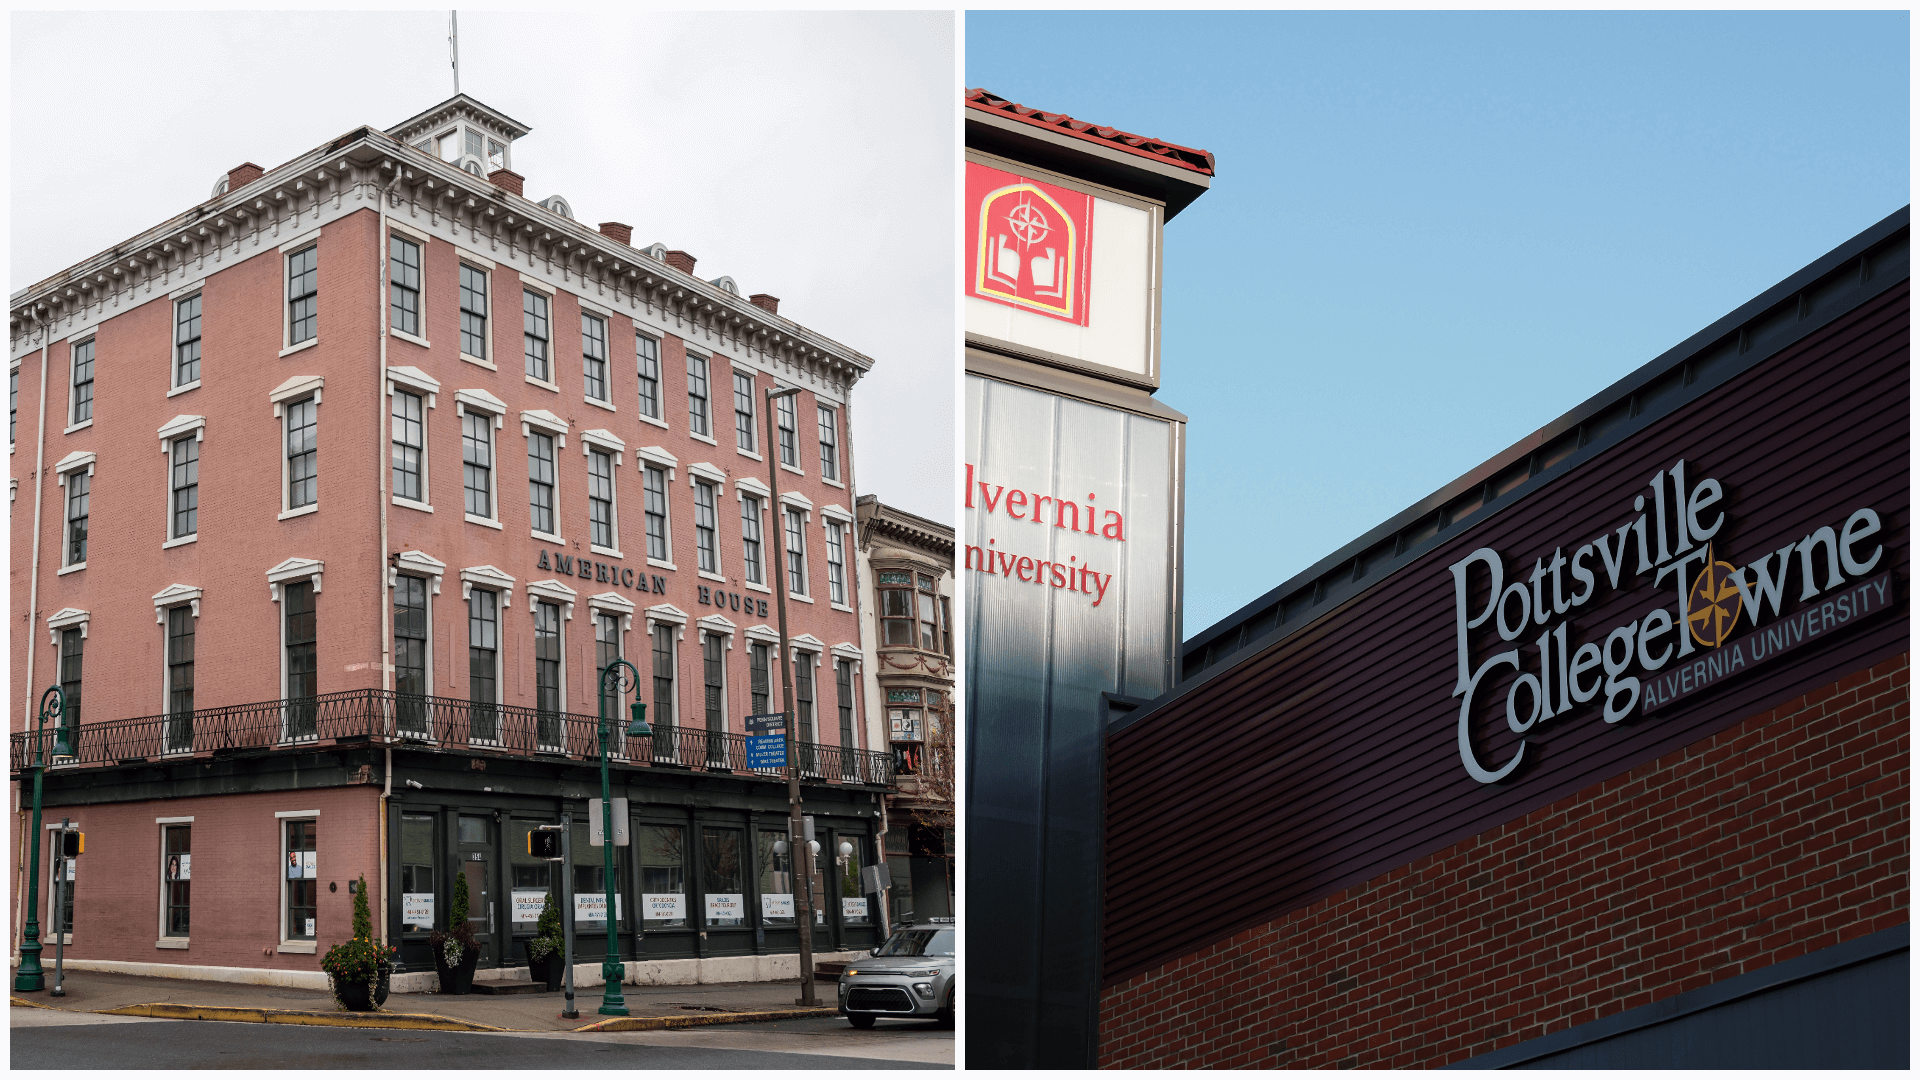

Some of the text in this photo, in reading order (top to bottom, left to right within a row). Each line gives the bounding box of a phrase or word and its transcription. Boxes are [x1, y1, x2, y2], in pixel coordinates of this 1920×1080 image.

[537, 549, 769, 617] AMERICAN HOUSE
[1449, 459, 1725, 698] Pottsville
[1643, 577, 1889, 710] ALVERNIA UNIVERSITY
